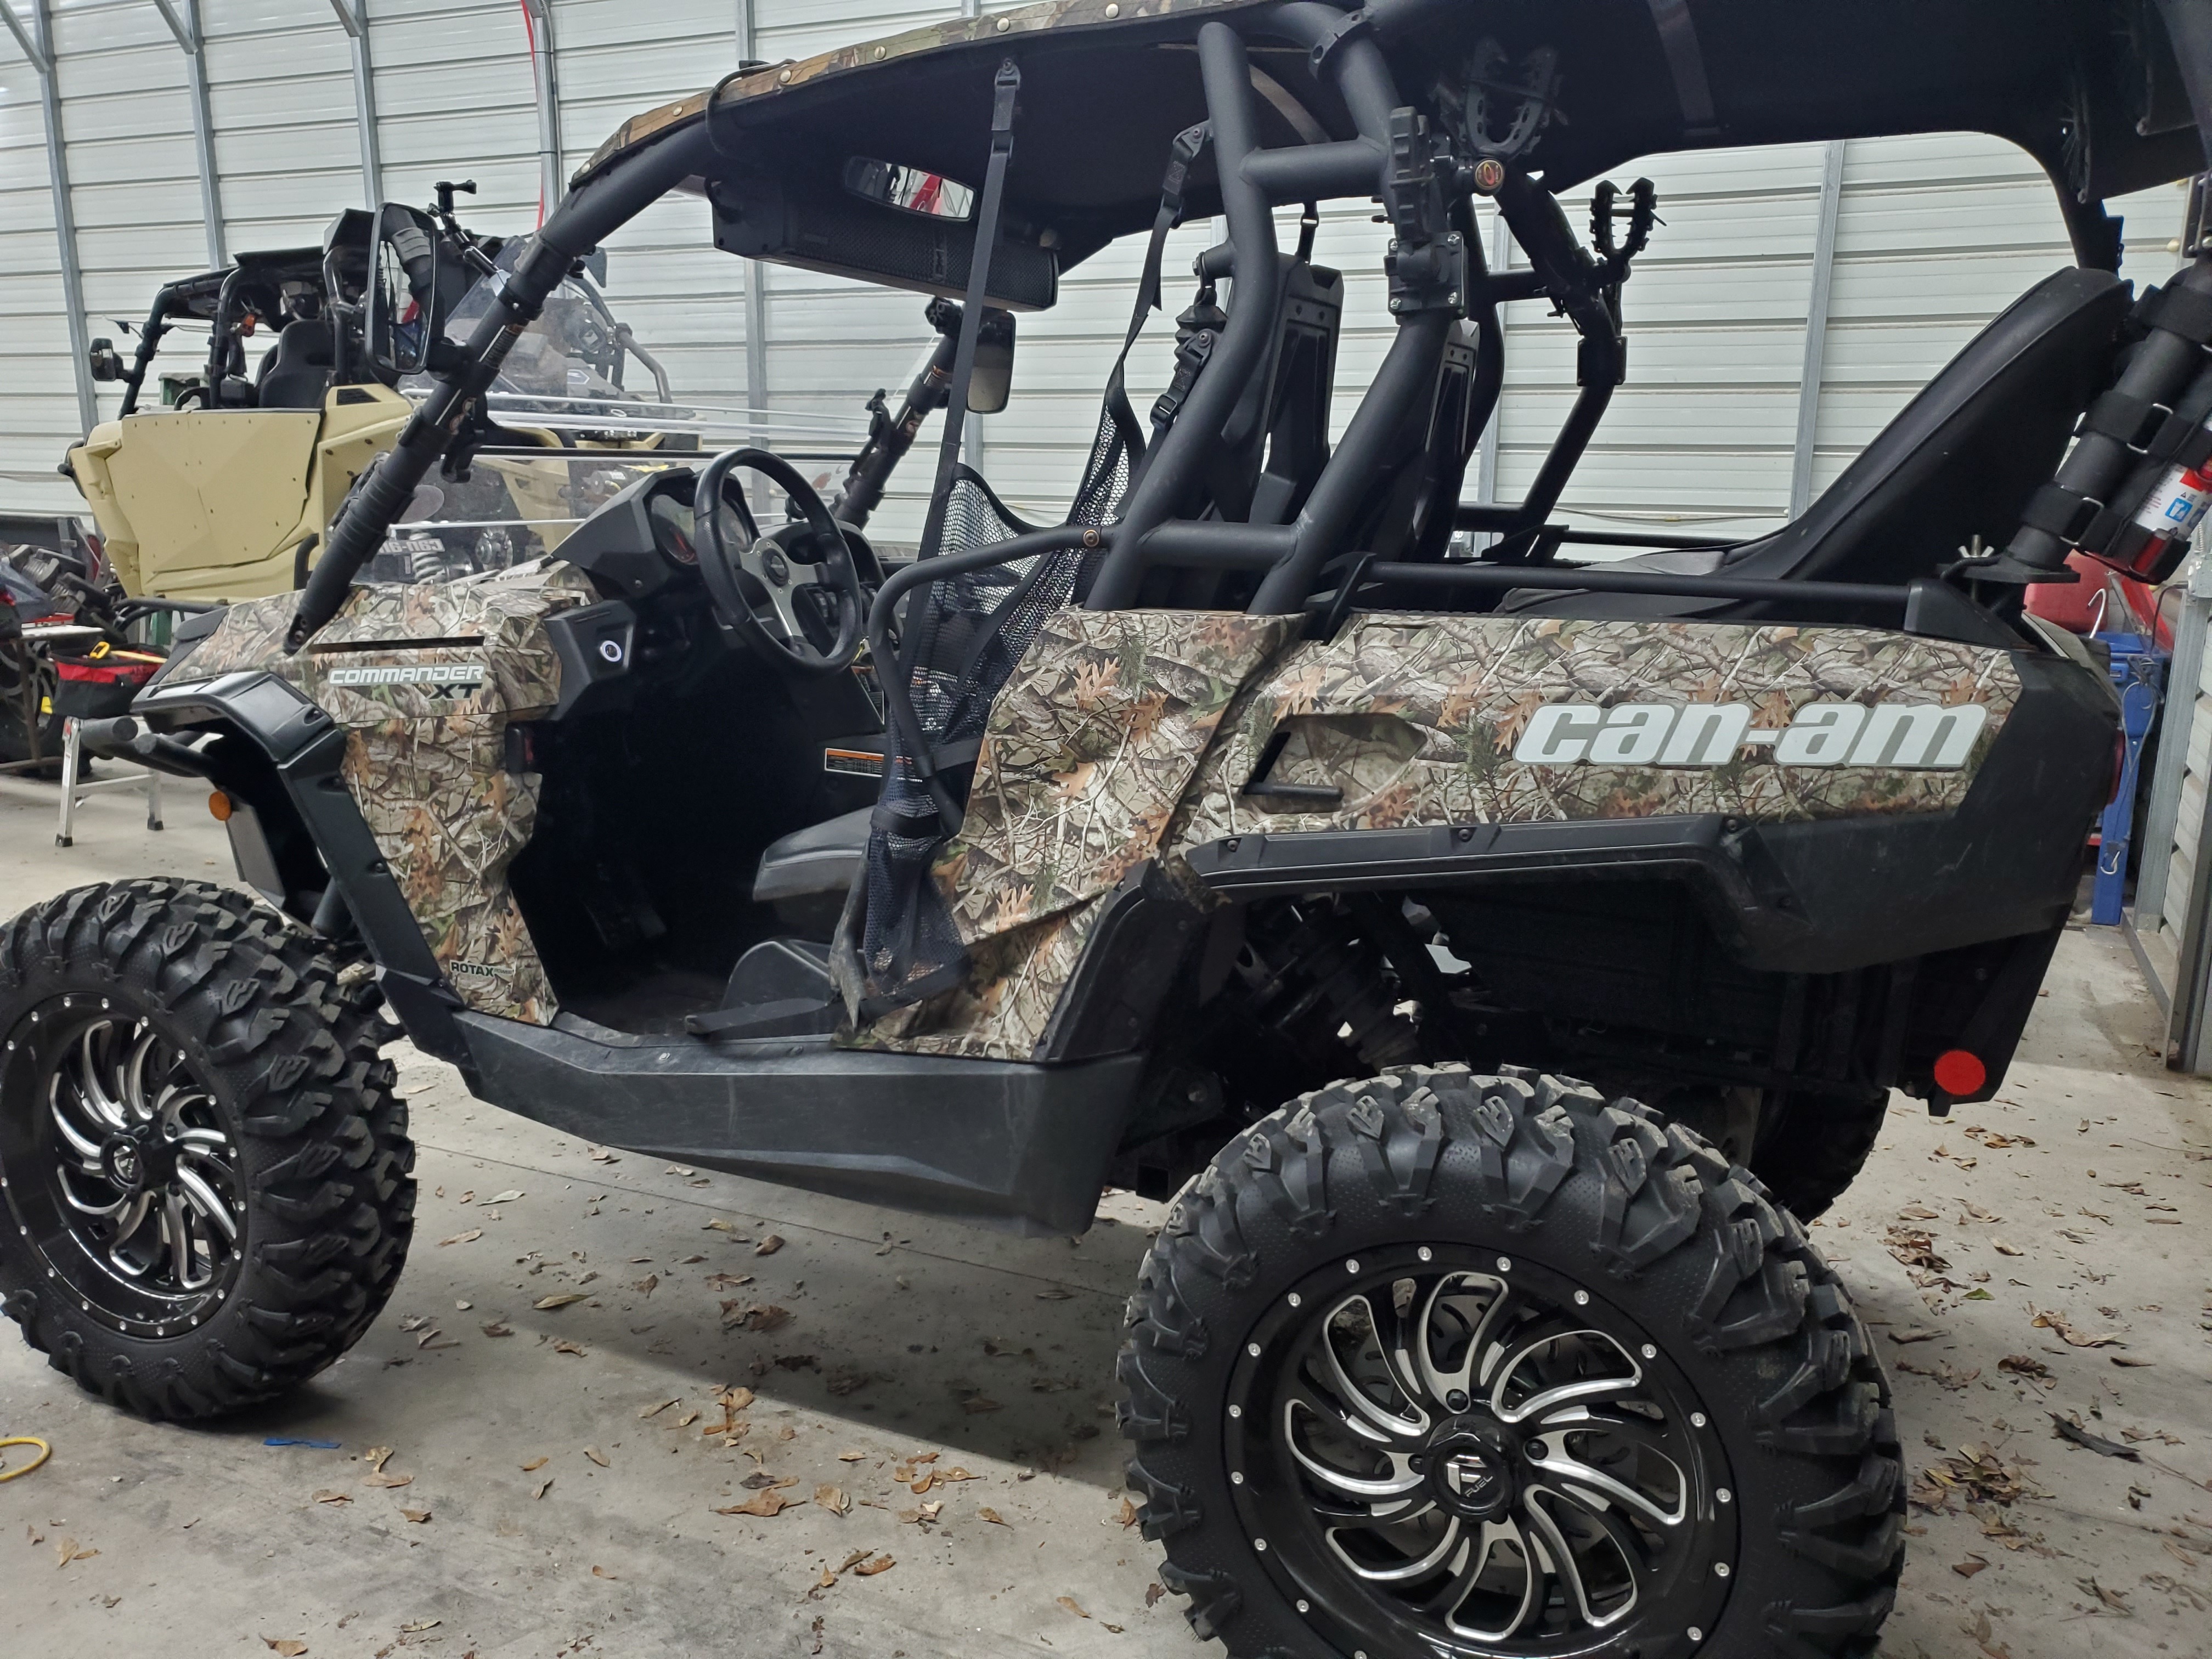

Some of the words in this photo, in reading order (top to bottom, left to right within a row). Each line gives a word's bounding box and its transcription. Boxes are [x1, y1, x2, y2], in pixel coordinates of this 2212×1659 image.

[329, 665, 484, 684] COMMANDER
[429, 683, 482, 699] XT
[1517, 703, 1986, 765] can-am
[451, 962, 494, 977] ROTAX
[1464, 1476, 1493, 1498] FUEL
